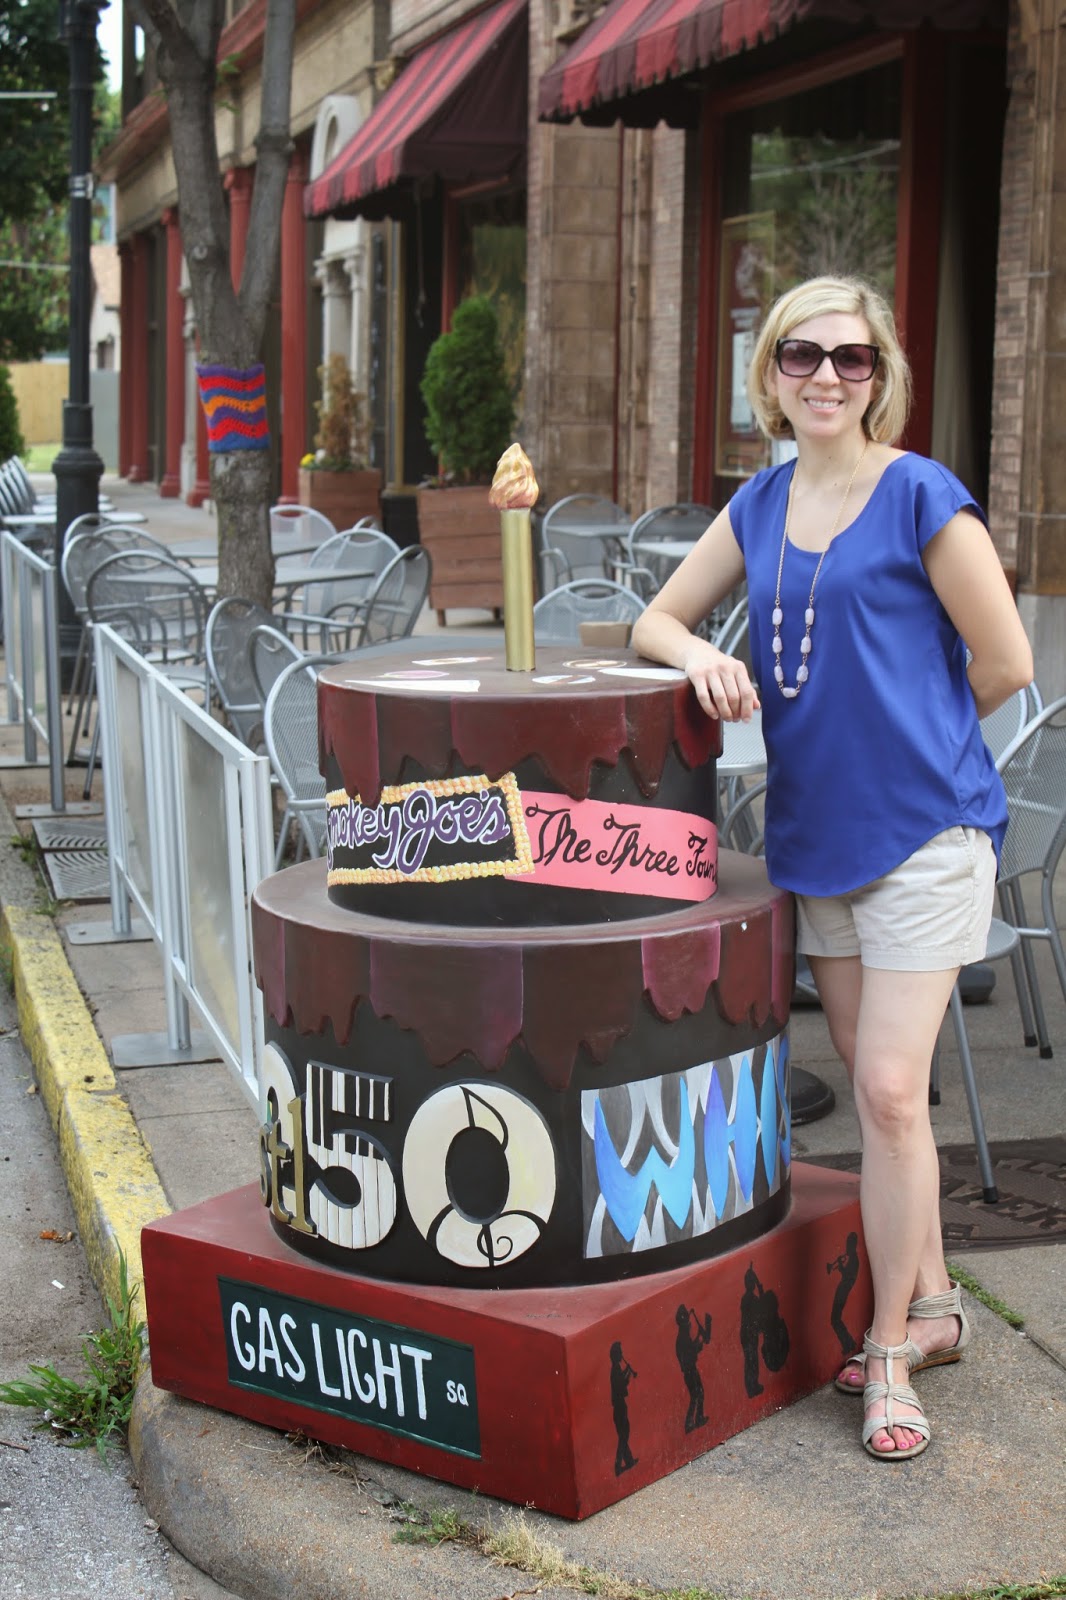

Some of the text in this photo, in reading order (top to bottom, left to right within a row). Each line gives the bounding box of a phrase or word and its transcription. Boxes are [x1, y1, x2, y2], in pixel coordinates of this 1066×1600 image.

[396, 788, 511, 875] Joe's
[525, 803, 718, 885] The Three Foun
[446, 1379, 469, 1406] SQ
